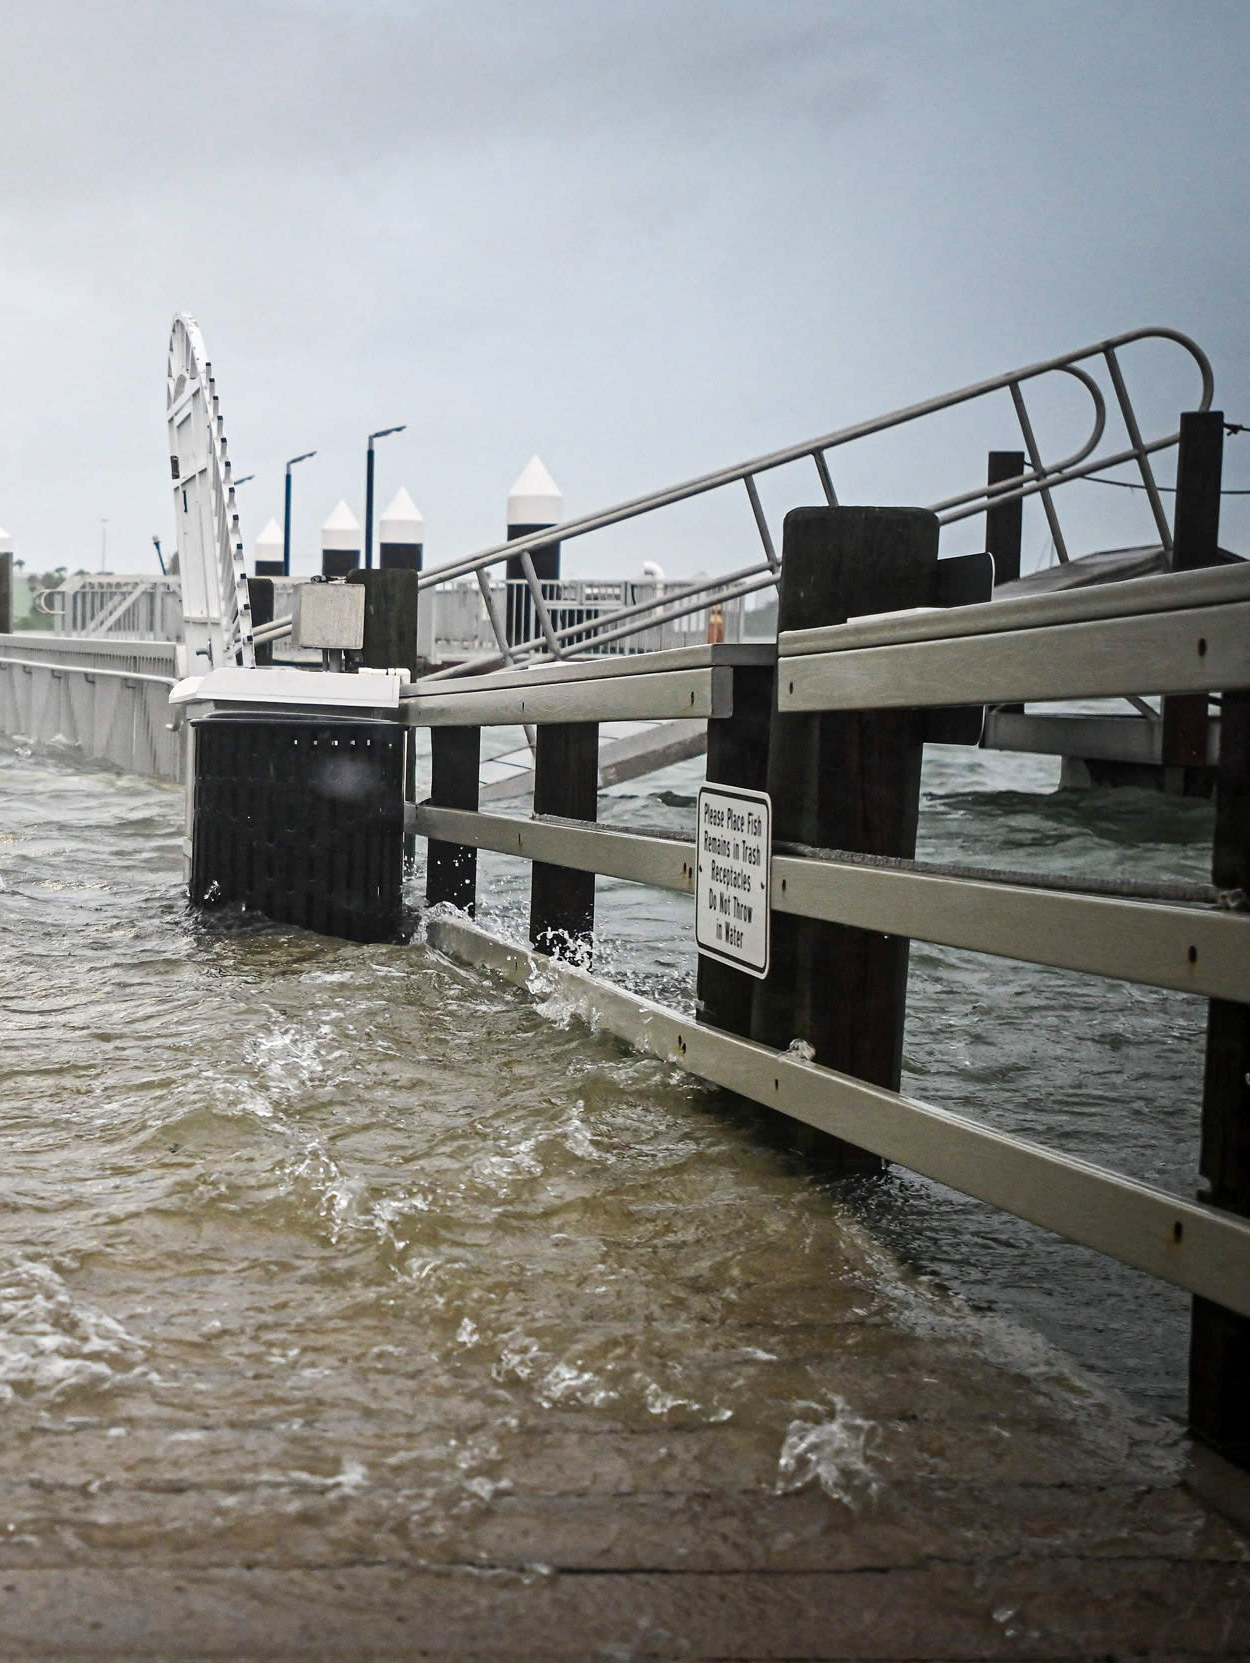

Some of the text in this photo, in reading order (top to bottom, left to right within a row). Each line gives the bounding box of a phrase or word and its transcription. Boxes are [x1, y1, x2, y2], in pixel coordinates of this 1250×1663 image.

[704, 802, 762, 837] Please Place Fish
[704, 830, 761, 866] Remains in Trash
[711, 859, 751, 892] Receptacles
[709, 888, 753, 923] Do Not Throw
[716, 918, 743, 949] in Water
